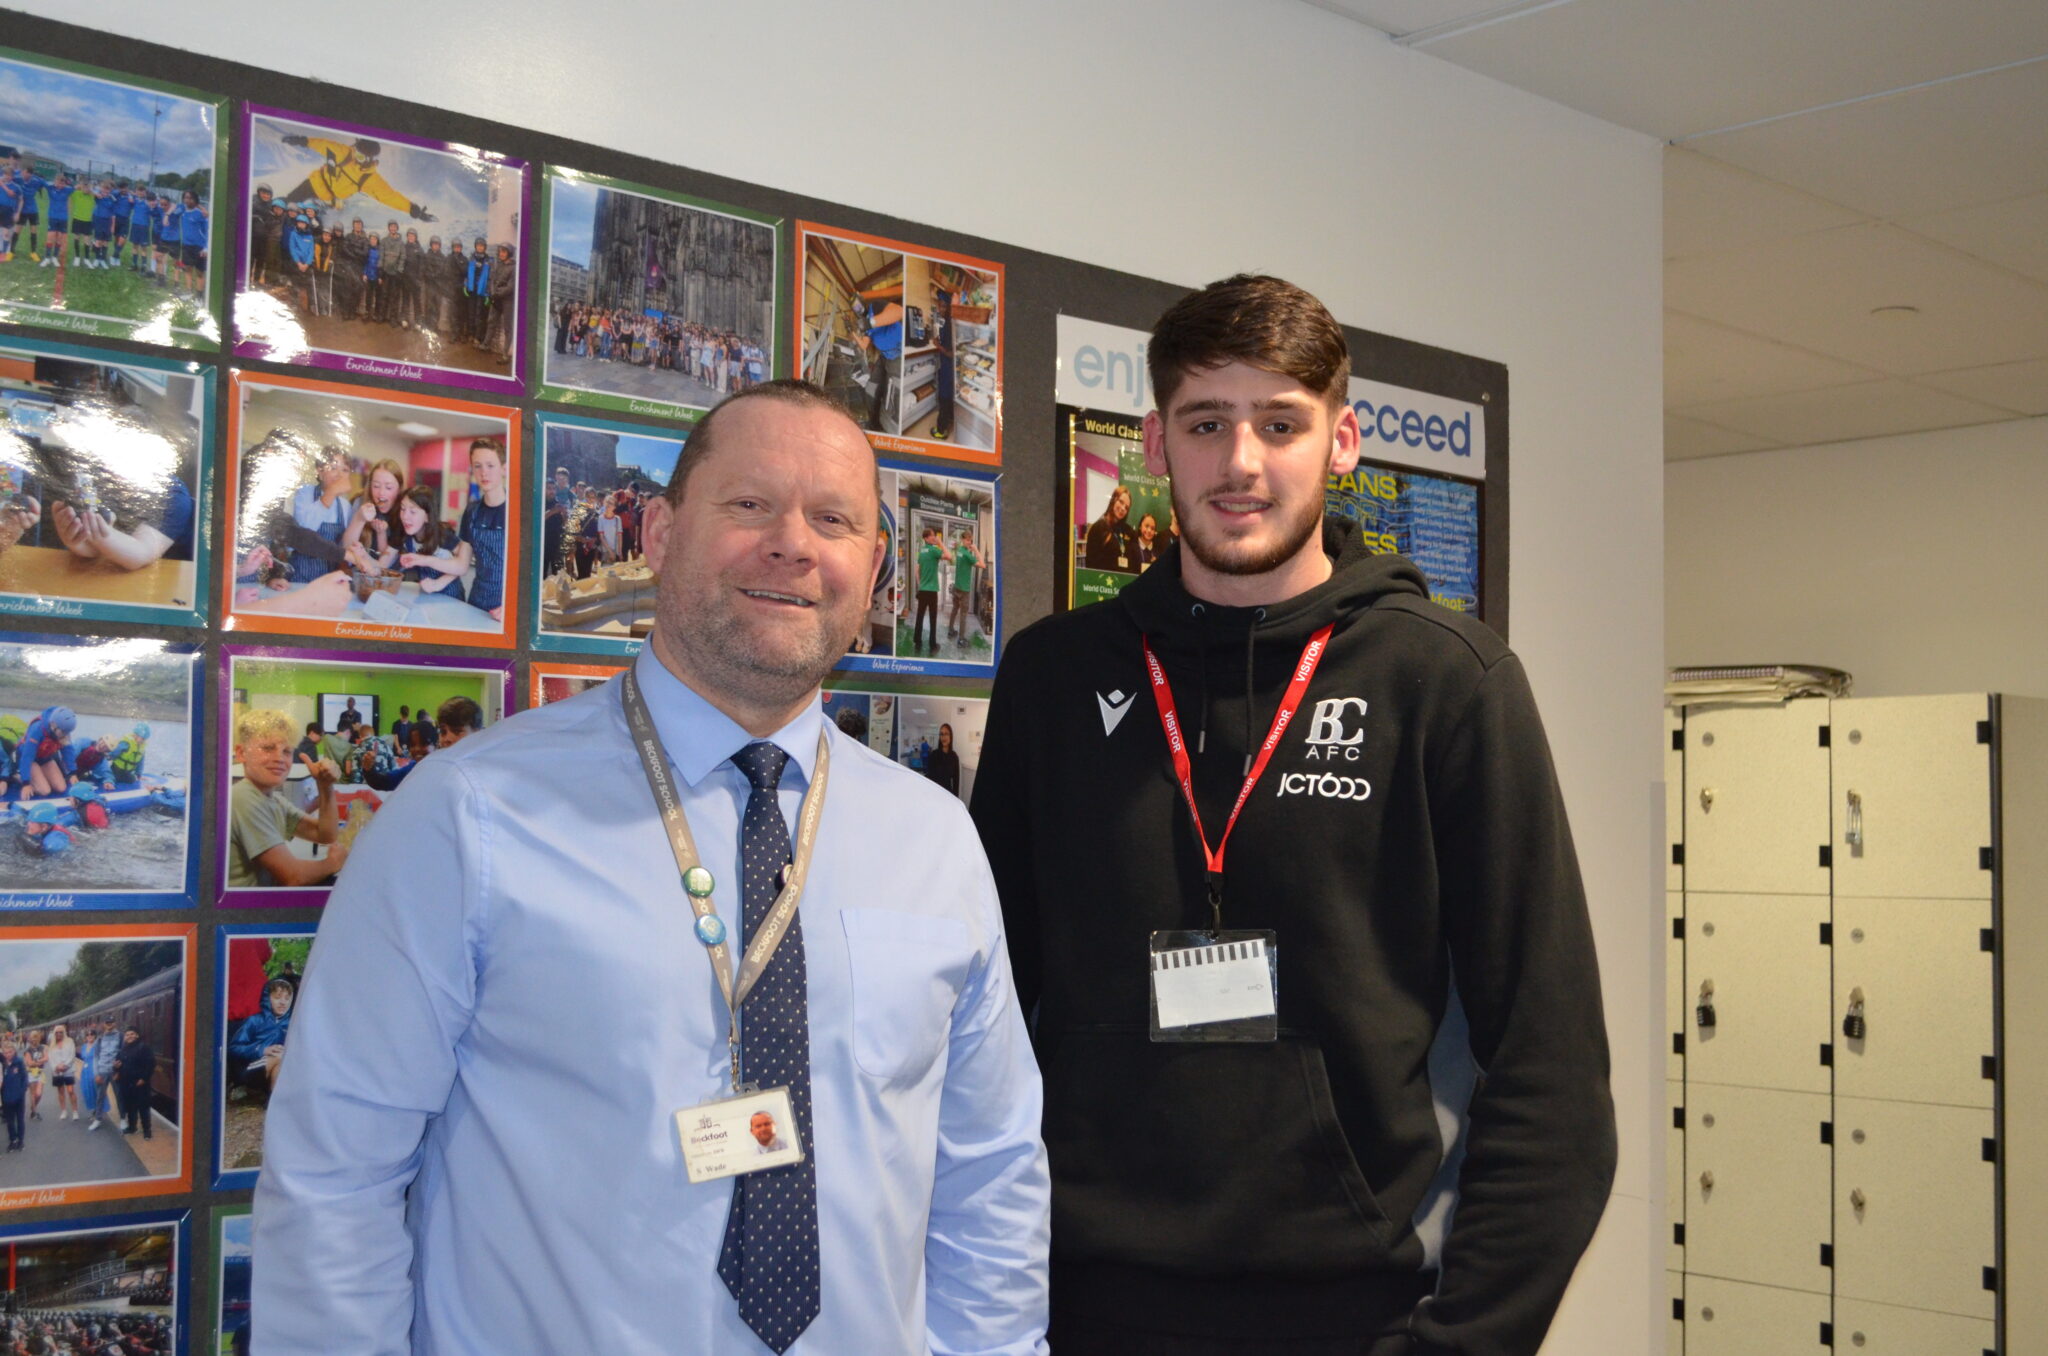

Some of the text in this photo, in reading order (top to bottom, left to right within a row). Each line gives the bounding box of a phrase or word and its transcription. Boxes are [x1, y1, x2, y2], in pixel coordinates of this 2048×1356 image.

[11, 309, 70, 328] nrichment
[345, 357, 423, 379] Enrichment Week
[1074, 343, 1153, 407] enj
[629, 400, 695, 420] Enrichment Week
[1085, 419, 1144, 440] World Class
[1346, 398, 1471, 457] cceed
[874, 435, 926, 453] Work Experience
[55, 600, 85, 616] Week
[335, 622, 413, 640] Enrichment Week
[872, 658, 925, 674] Work Experience
[1296, 640, 1322, 682] VISITOR
[1164, 710, 1181, 753] VISITOR
[1263, 709, 1292, 751] VISITOR
[1304, 697, 1368, 745] BC
[643, 739, 679, 821] BECKFOOT SCHOOL
[1230, 777, 1255, 820] VISITOR
[45, 893, 75, 908] Week
[749, 883, 799, 964] BECKFOOT SCHOOL
[38, 1188, 66, 1204] Week
